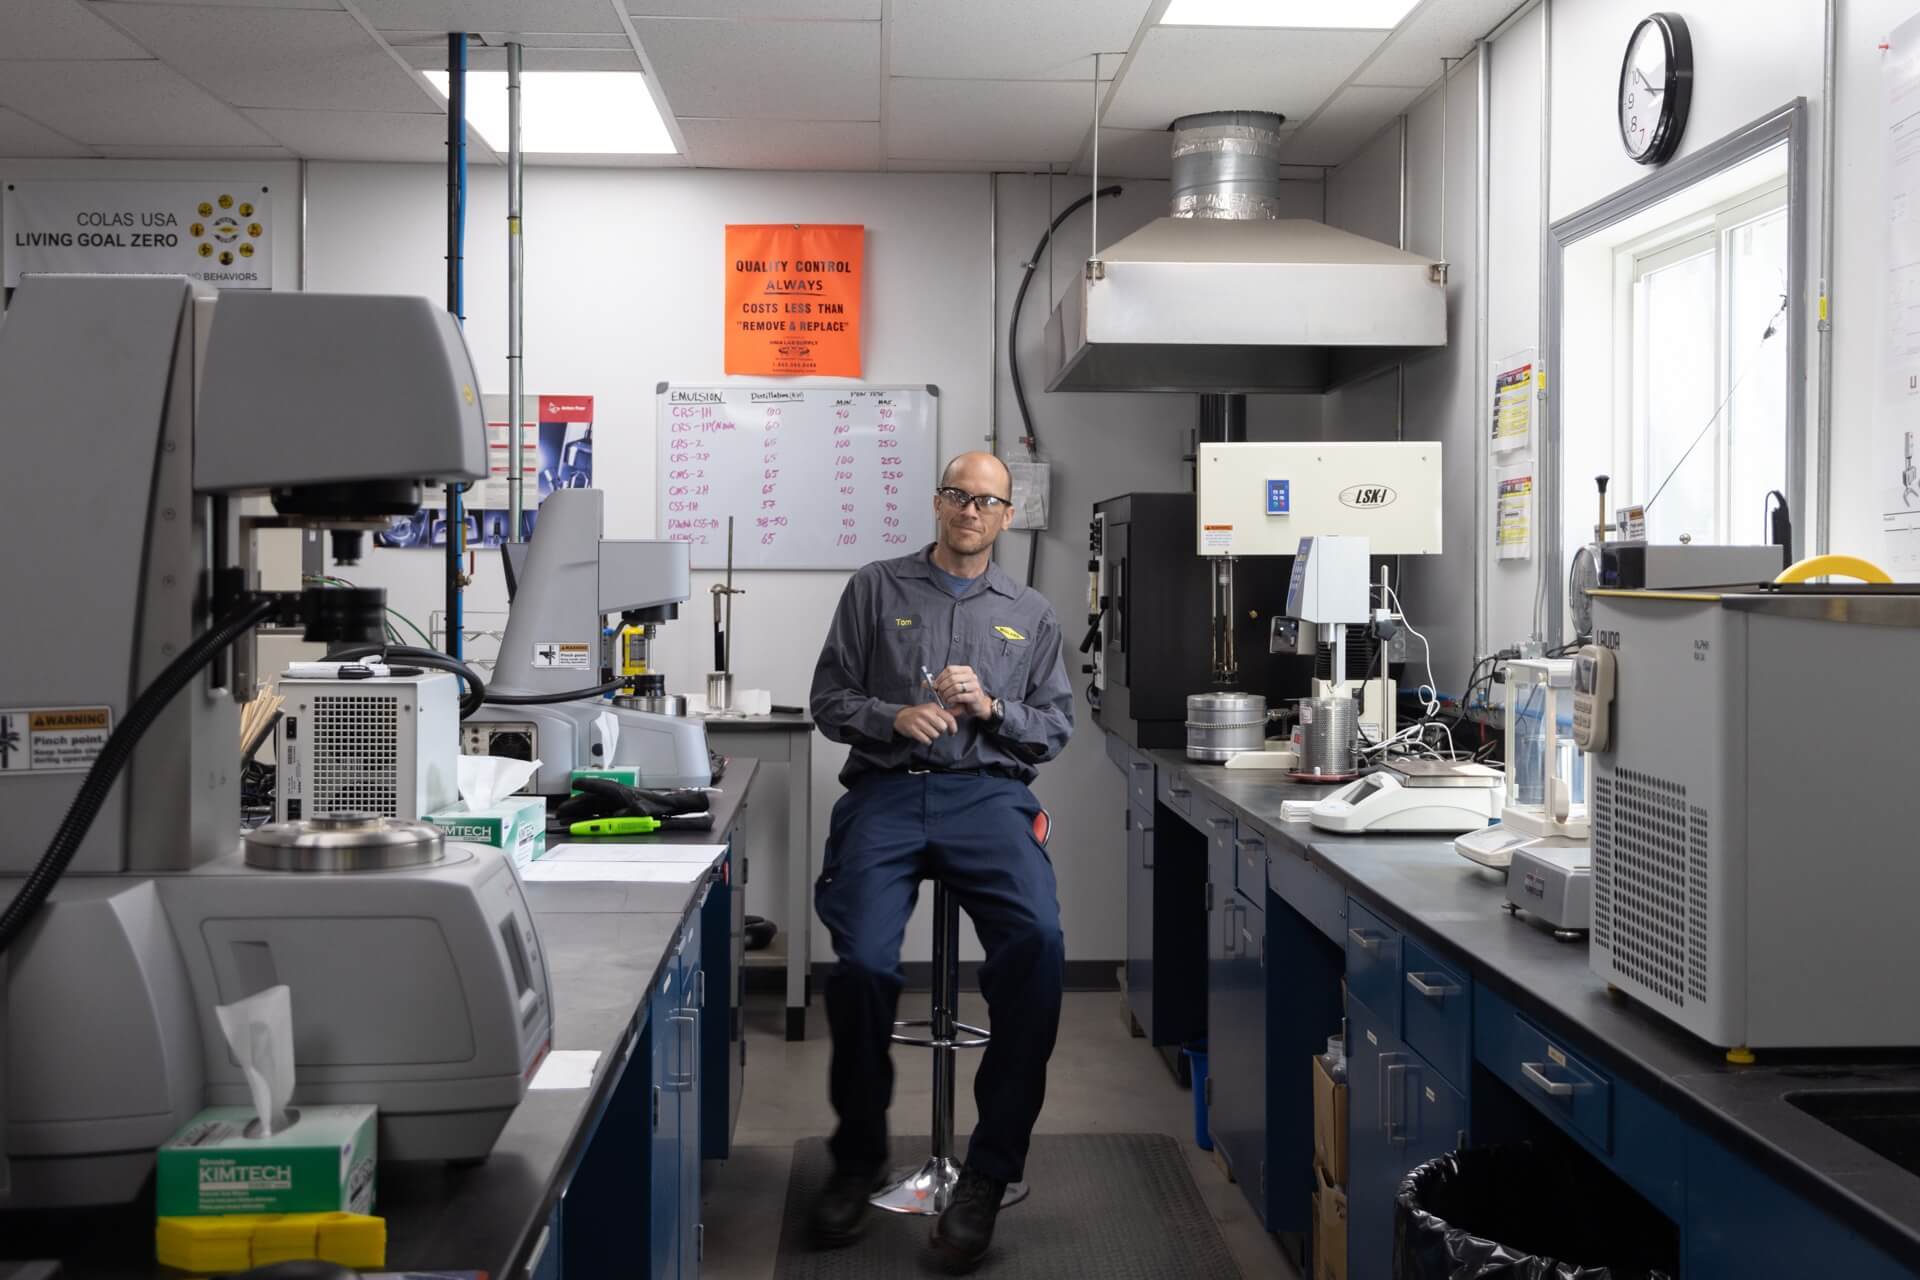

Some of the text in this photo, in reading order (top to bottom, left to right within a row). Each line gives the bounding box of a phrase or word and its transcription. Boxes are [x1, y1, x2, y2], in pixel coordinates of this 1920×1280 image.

[1628, 92, 1635, 110] 9
[1631, 115, 1637, 133] 8
[1639, 128, 1645, 145] 7
[76, 212, 178, 227] COLAS USA
[15, 232, 178, 248] LIVING GOAL ZERO
[736, 260, 851, 273] QUALITY CONTROL
[203, 272, 258, 281] BEHAVIORS
[766, 279, 823, 291] ALWAYS
[743, 303, 844, 314] COSTS LESS THAN
[671, 391, 723, 402] EMULSION
[836, 409, 849, 418] 40
[878, 440, 898, 448] 250
[881, 457, 902, 465] 250
[764, 469, 779, 480] 65
[881, 471, 904, 480] 250
[840, 486, 855, 496] 40
[884, 484, 898, 495] 90
[841, 503, 854, 513] 40
[842, 519, 855, 528] 40
[884, 516, 899, 528] 90
[761, 532, 776, 545] 65
[836, 533, 857, 546] 100
[882, 533, 907, 545] 200
[895, 618, 912, 627] Tom
[46, 713, 105, 726] WARNING
[34, 736, 68, 745] Pinch
[199, 1166, 291, 1182] KIMTECH
